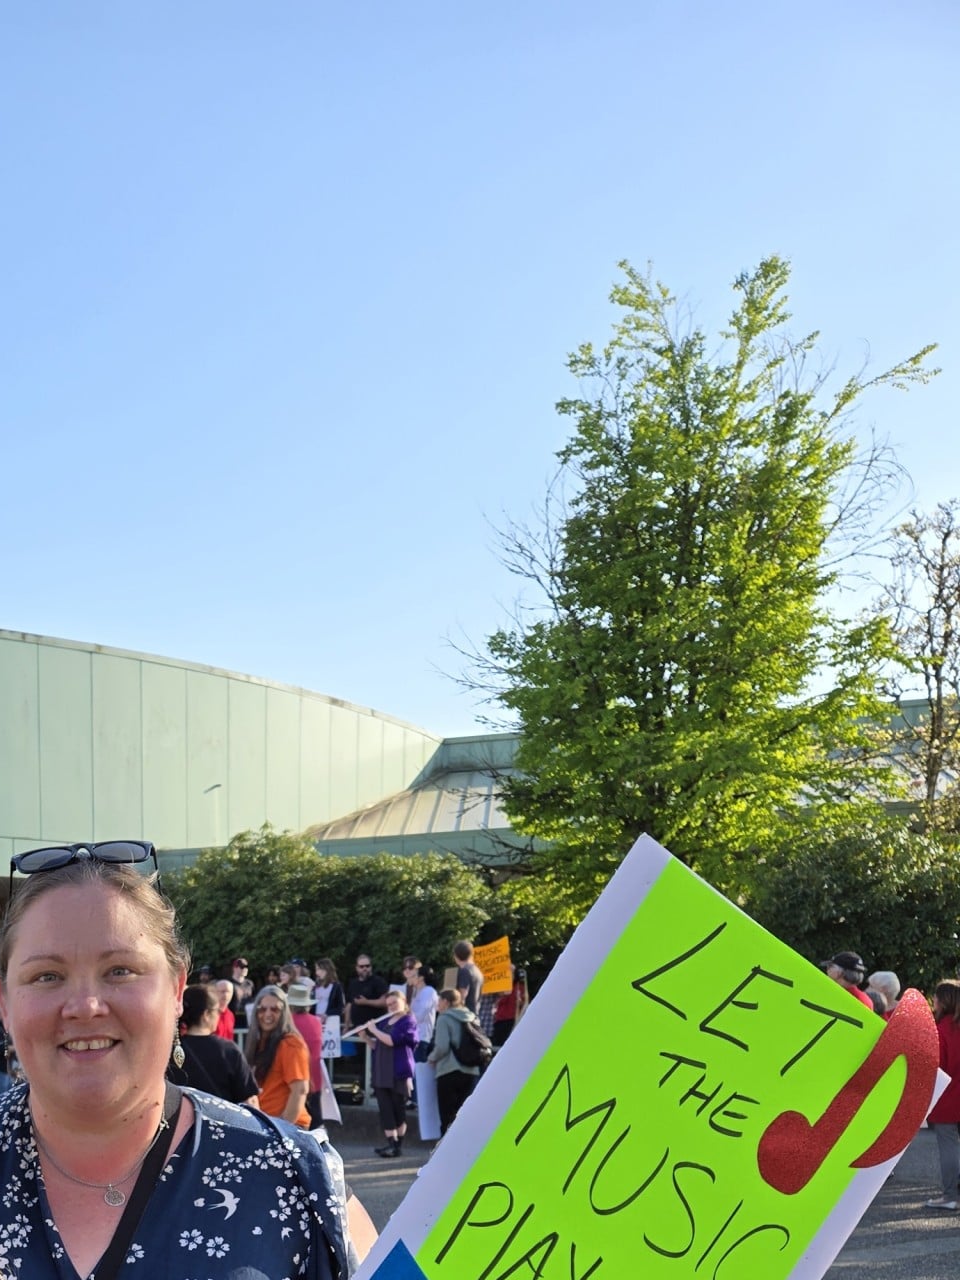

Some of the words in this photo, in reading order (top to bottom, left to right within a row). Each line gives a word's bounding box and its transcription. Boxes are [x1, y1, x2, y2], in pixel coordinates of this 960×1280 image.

[473, 946, 500, 959] MUSIC
[631, 921, 864, 1077] LET
[657, 1052, 761, 1137] THE
